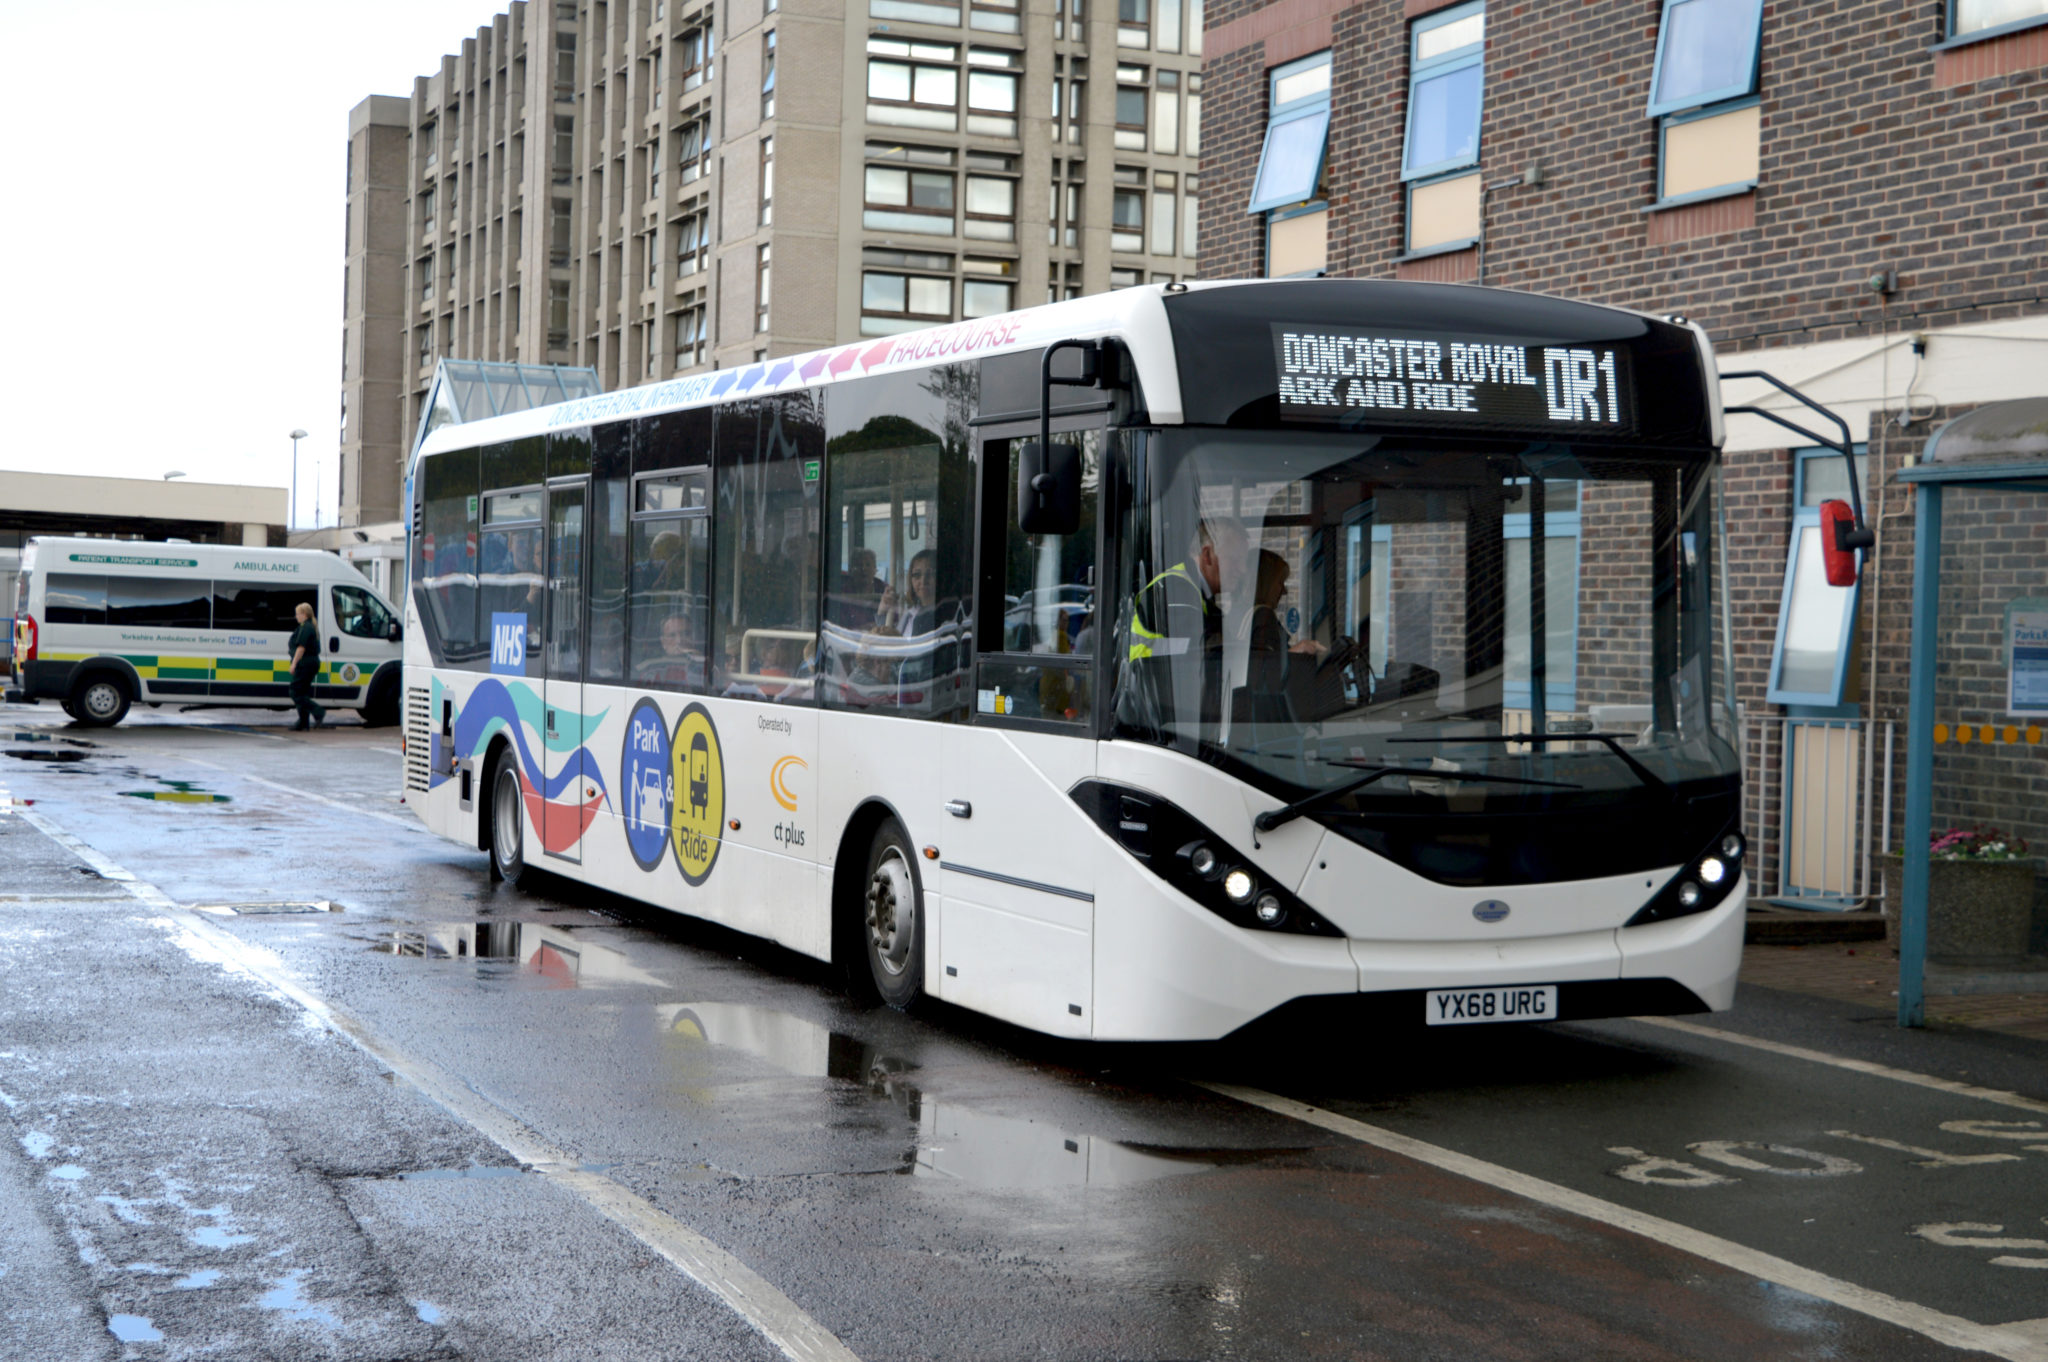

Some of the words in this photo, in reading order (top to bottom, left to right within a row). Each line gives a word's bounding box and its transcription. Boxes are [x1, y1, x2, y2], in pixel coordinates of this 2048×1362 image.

[889, 312, 1030, 364] RACECOURSE
[1282, 333, 1442, 381] DONCASTER
[1450, 342, 1537, 385] ROYAL
[548, 396, 614, 427] DONCASTER
[610, 389, 646, 415] ROYAL
[644, 376, 714, 408] INFIRMARY
[1278, 376, 1340, 407] ARK
[1345, 379, 1407, 410] AND
[1411, 382, 1479, 413] RIDE
[1543, 347, 1620, 423] DR1
[110, 556, 156, 565] TRANSPORT
[158, 558, 190, 567] SERVICE
[233, 561, 300, 573] AMBULANCE
[121, 633, 154, 641] Yorkshire
[156, 634, 196, 643] Ambulance
[198, 635, 226, 644] Service
[250, 637, 267, 645] Trust
[492, 624, 524, 667] NHS
[634, 720, 660, 754] Park
[758, 715, 783, 733] Operated
[784, 719, 792, 736] by
[665, 774, 674, 803] &
[680, 826, 708, 863] Ride
[774, 821, 783, 842] ct
[785, 821, 805, 849] plus
[1437, 992, 1496, 1019] YX68
[1502, 990, 1546, 1016] URG
